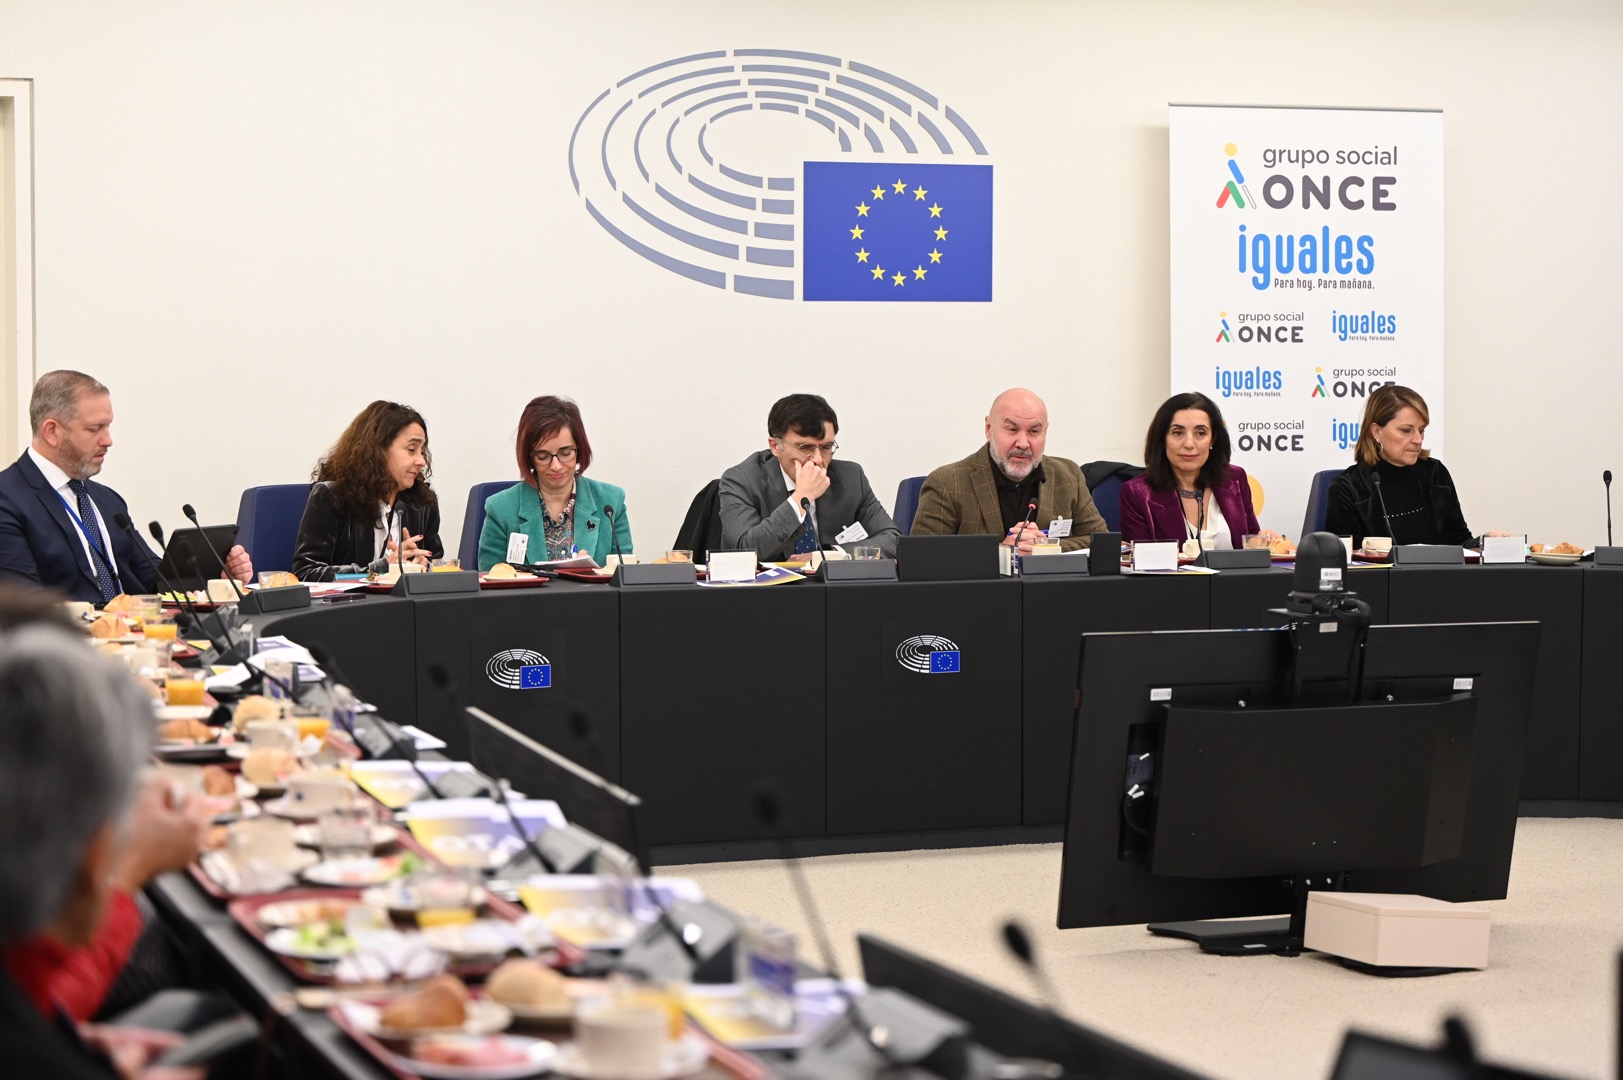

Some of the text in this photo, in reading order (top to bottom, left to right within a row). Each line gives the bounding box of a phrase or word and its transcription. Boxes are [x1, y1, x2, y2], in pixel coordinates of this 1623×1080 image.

[1263, 145, 1398, 169] grupo social
[1262, 174, 1397, 211] ONCE
[1238, 224, 1375, 290] iguales
[1274, 277, 1375, 291] Para hoy. Para mañana.
[1238, 311, 1304, 323] grupo social
[1238, 326, 1304, 343] ONCE
[1332, 310, 1396, 342] iguales
[1333, 367, 1396, 378] grupo social
[1215, 366, 1282, 398] iguales
[1238, 420, 1304, 432] grupo social
[1238, 434, 1304, 451] ONCE
